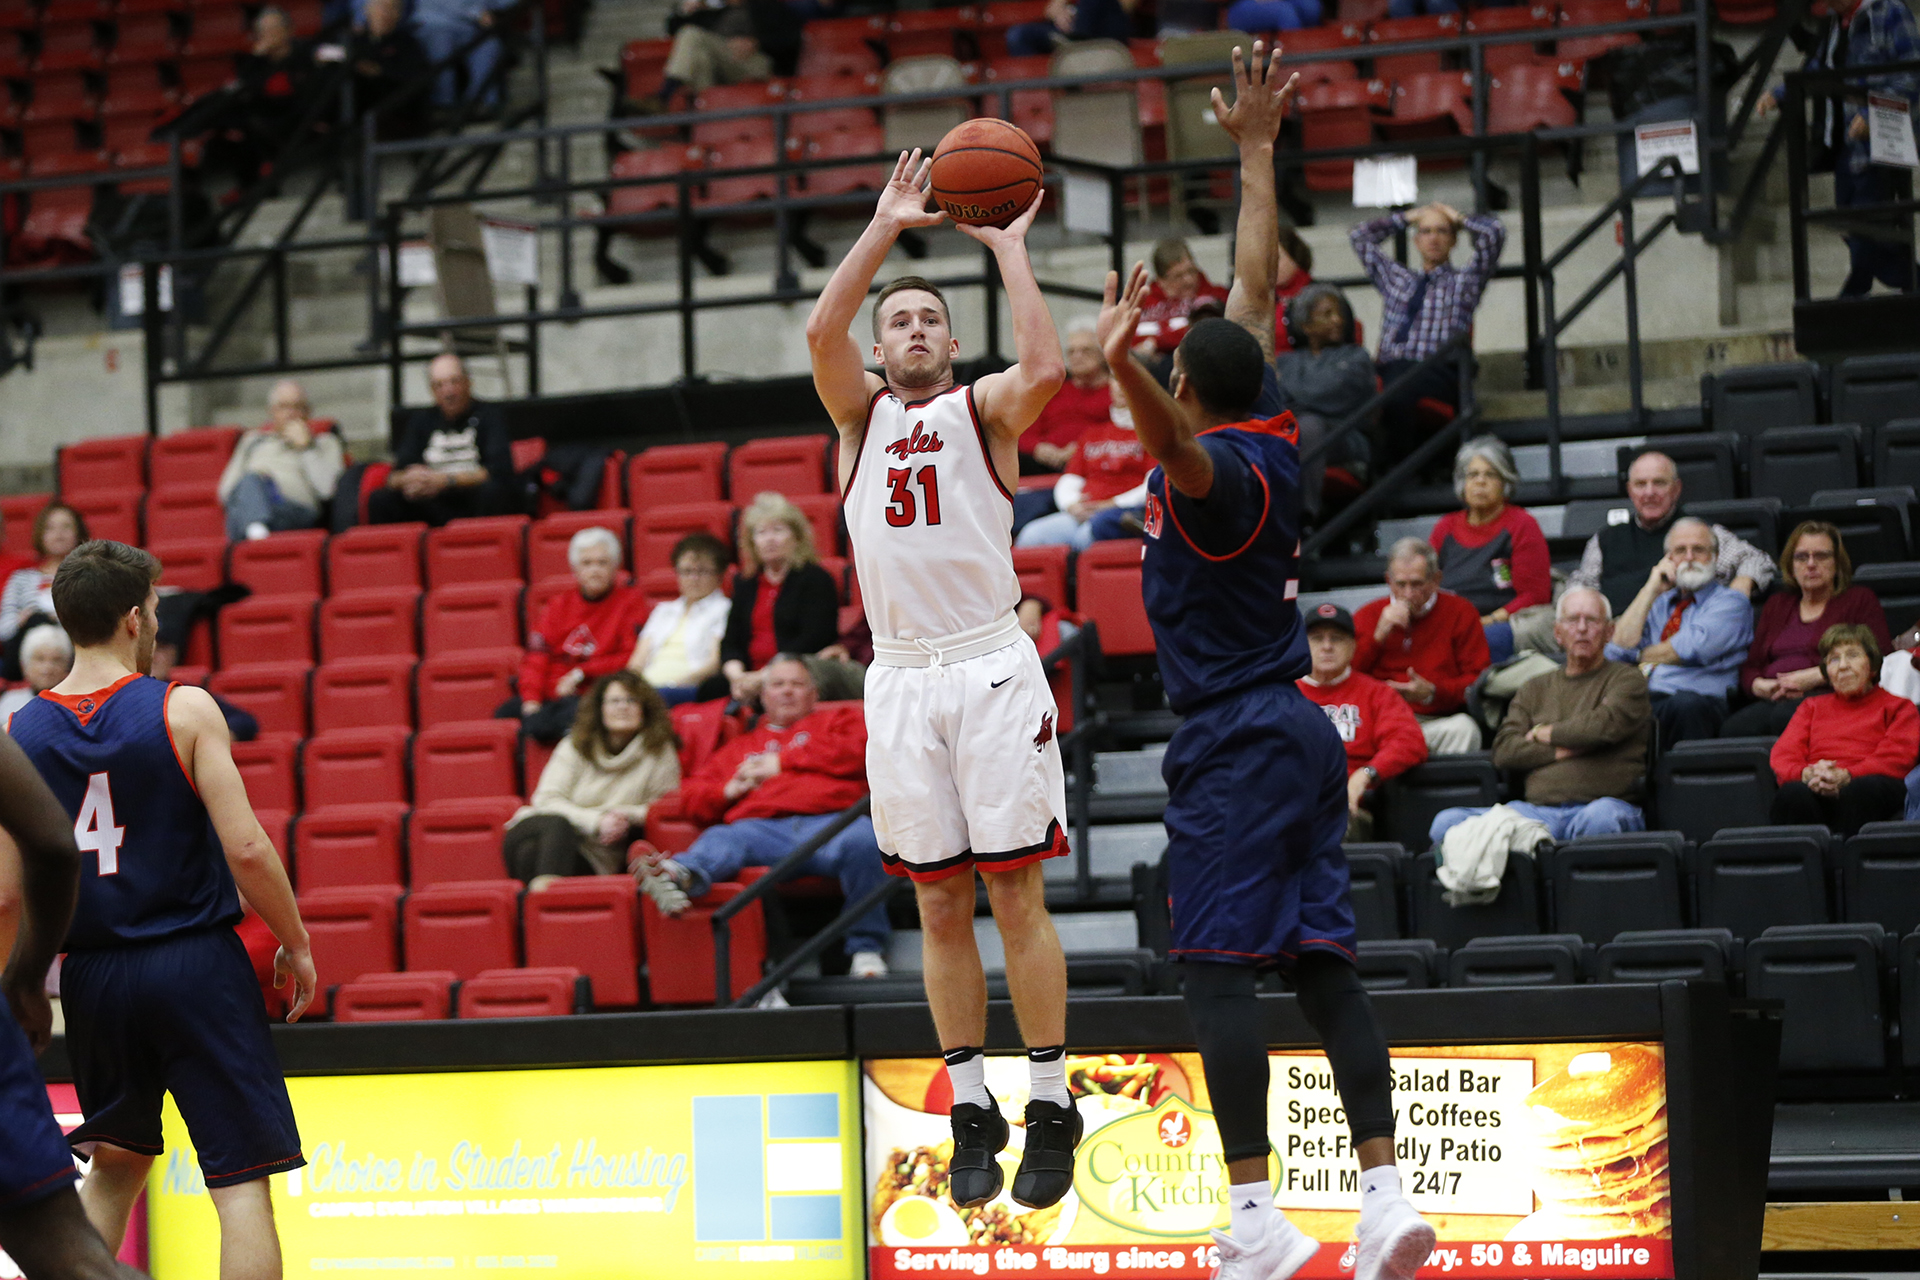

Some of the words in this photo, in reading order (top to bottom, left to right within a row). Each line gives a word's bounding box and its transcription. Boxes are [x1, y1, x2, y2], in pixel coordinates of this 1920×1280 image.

[943, 199, 1017, 219] Wilson
[885, 464, 942, 527] 31
[73, 770, 126, 877] 4
[1459, 1069, 1502, 1093] Bar
[1409, 1102, 1502, 1128] Coffees
[1441, 1138, 1502, 1162] Patio
[307, 1138, 403, 1192] Choice
[408, 1150, 441, 1191] in
[444, 1138, 561, 1190] Student
[567, 1136, 690, 1214] Housing
[1288, 1168, 1329, 1191] Full
[1412, 1171, 1462, 1195] 24/7
[1129, 1174, 1230, 1212] Kitche
[894, 1248, 989, 1275] Serving
[995, 1248, 1037, 1270] the
[1115, 1246, 1186, 1269] since
[1423, 1249, 1463, 1272] wy.
[1470, 1243, 1503, 1267] 50
[1511, 1243, 1533, 1266] &
[1541, 1243, 1650, 1271] Maguire
